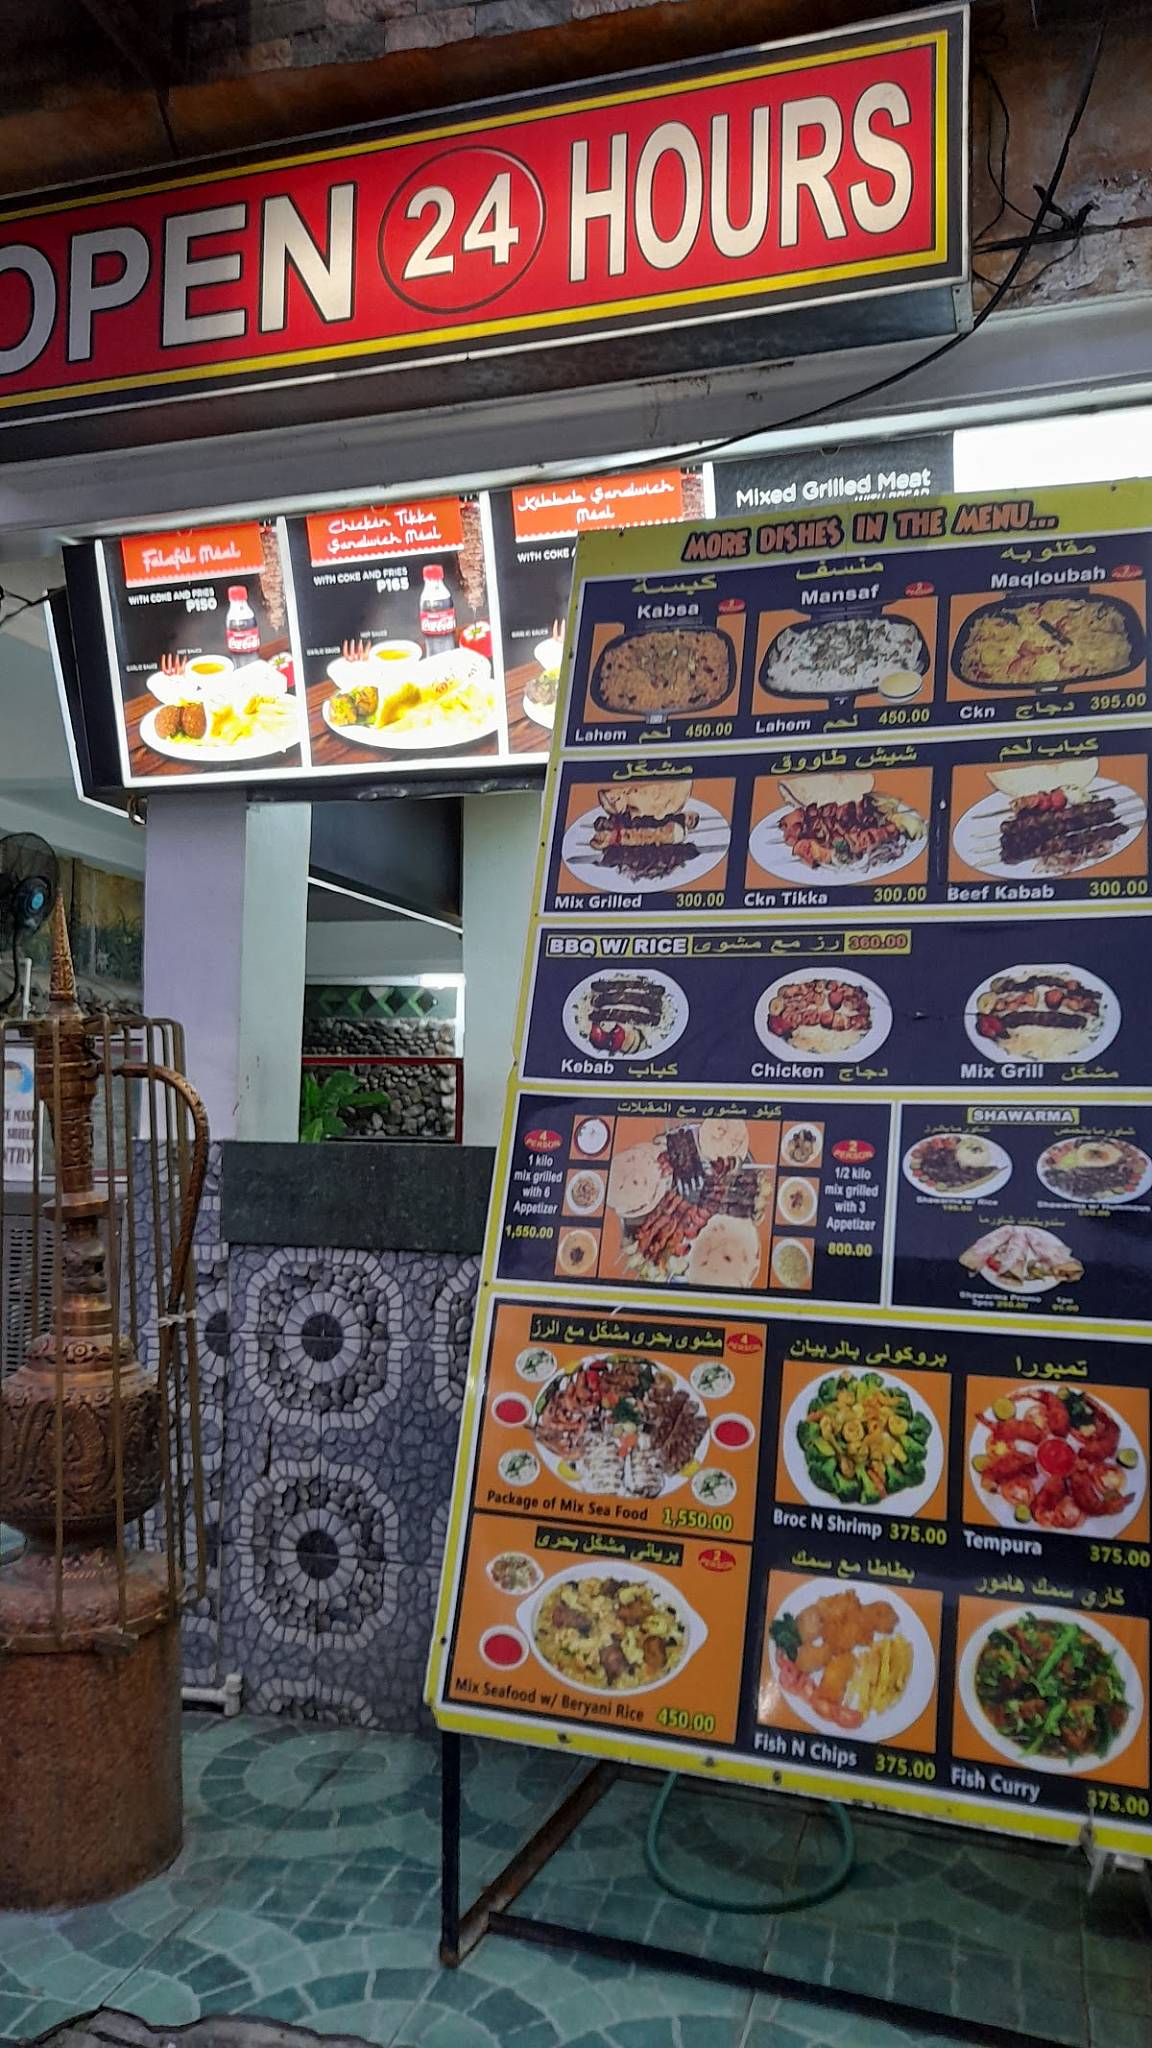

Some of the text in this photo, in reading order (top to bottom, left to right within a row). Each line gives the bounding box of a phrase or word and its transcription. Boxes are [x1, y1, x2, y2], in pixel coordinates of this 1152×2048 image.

[0, 82, 912, 376] OPEN 24 HOURS
[590, 479, 675, 504] Sandwich
[736, 483, 797, 508] Mixed
[802, 474, 871, 500] Grilled
[878, 467, 931, 493] Meat
[328, 508, 437, 534] Chicken Tikka
[576, 505, 615, 524] Meal
[327, 526, 442, 553] Sandwich Meal
[682, 528, 751, 562] MORE
[756, 515, 844, 554] DISHES
[852, 512, 888, 543] IN
[895, 507, 947, 540] THE
[517, 551, 542, 564] WITH
[543, 548, 569, 561] COKE
[313, 566, 408, 587] WITH COKE AND FRIES
[377, 577, 410, 593] P165
[991, 566, 1106, 589] Maqloubah
[128, 595, 150, 606] WITH
[150, 591, 173, 604] COKE
[174, 589, 192, 601] AND
[801, 583, 880, 606] Mansaf
[186, 598, 218, 613] P150
[637, 602, 699, 620] Kabsa
[1015, 701, 1075, 720] دجاج
[1090, 692, 1147, 711] 395.00
[878, 708, 930, 725] 450.00
[960, 705, 996, 720] Ckn
[685, 722, 733, 738] 450.00
[755, 719, 811, 734] Lahem
[823, 714, 858, 732] لحم
[575, 727, 627, 742] Lahem
[638, 726, 672, 744] لحم
[855, 745, 918, 769] شيش
[999, 738, 1032, 761] لحم
[873, 886, 927, 902] 300.00
[946, 883, 1055, 901] Beef Kabab
[1089, 880, 1148, 897] 300.00
[554, 894, 642, 909] Mix Grilled
[676, 892, 726, 908] 300.00
[744, 890, 828, 907] Ckn Tikka
[549, 935, 689, 956] BBQ W/ RICE
[770, 938, 801, 955] مع
[848, 933, 909, 950] 360.00
[560, 1059, 614, 1075] Kebab
[628, 1062, 679, 1078] كباب
[751, 1063, 825, 1078] Chicken
[838, 1064, 888, 1081] دجاج
[960, 1063, 1044, 1079] Mix Grill
[972, 1108, 1074, 1123] SHAWARMA
[535, 1154, 553, 1167] kilo
[514, 1170, 562, 1184] mix grilled
[835, 1166, 872, 1180] 1/2 kilo
[523, 1186, 543, 1198] with
[825, 1184, 879, 1199] mix grilled
[513, 1201, 559, 1215] Appetizer
[835, 1201, 857, 1213] with
[826, 1216, 876, 1232] Appetizer
[828, 1243, 873, 1257] 800.00
[564, 1324, 585, 1343] مع
[487, 1490, 648, 1521] Package of Mix Sea Food
[662, 1507, 733, 1533] 1,550.00
[773, 1508, 883, 1540] Broc N Shrimp
[889, 1523, 947, 1546] 375.00
[963, 1530, 1043, 1556] Tempura
[1089, 1544, 1151, 1568] 375.00
[837, 1559, 861, 1579] مع
[455, 1677, 645, 1723] Mix Seafood w/ Beryani Rice
[656, 1706, 716, 1734] 450.00
[754, 1732, 858, 1768] Fish N Chips
[874, 1754, 937, 1782] 375.00
[950, 1765, 1041, 1804] Fish Curry
[1086, 1788, 1150, 1818] 375.00
